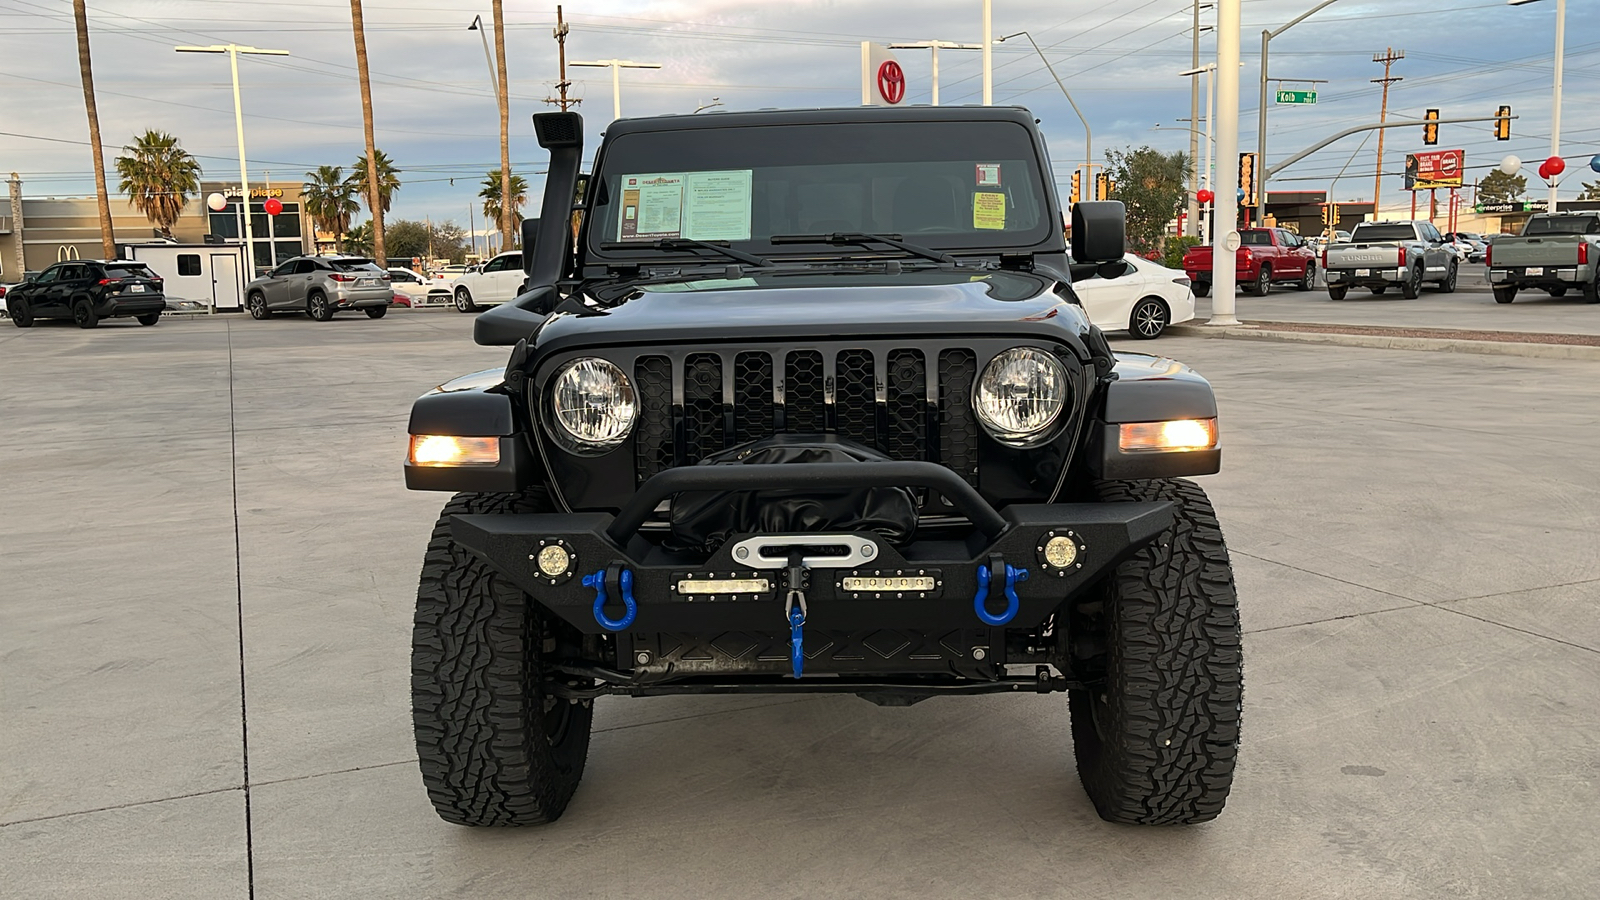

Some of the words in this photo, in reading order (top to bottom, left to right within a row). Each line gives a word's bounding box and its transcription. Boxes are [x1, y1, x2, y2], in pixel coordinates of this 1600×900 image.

[1280, 92, 1295, 102] Kolb
[1476, 204, 1513, 212] enterprise
[1341, 254, 1383, 262] TUNDRA
